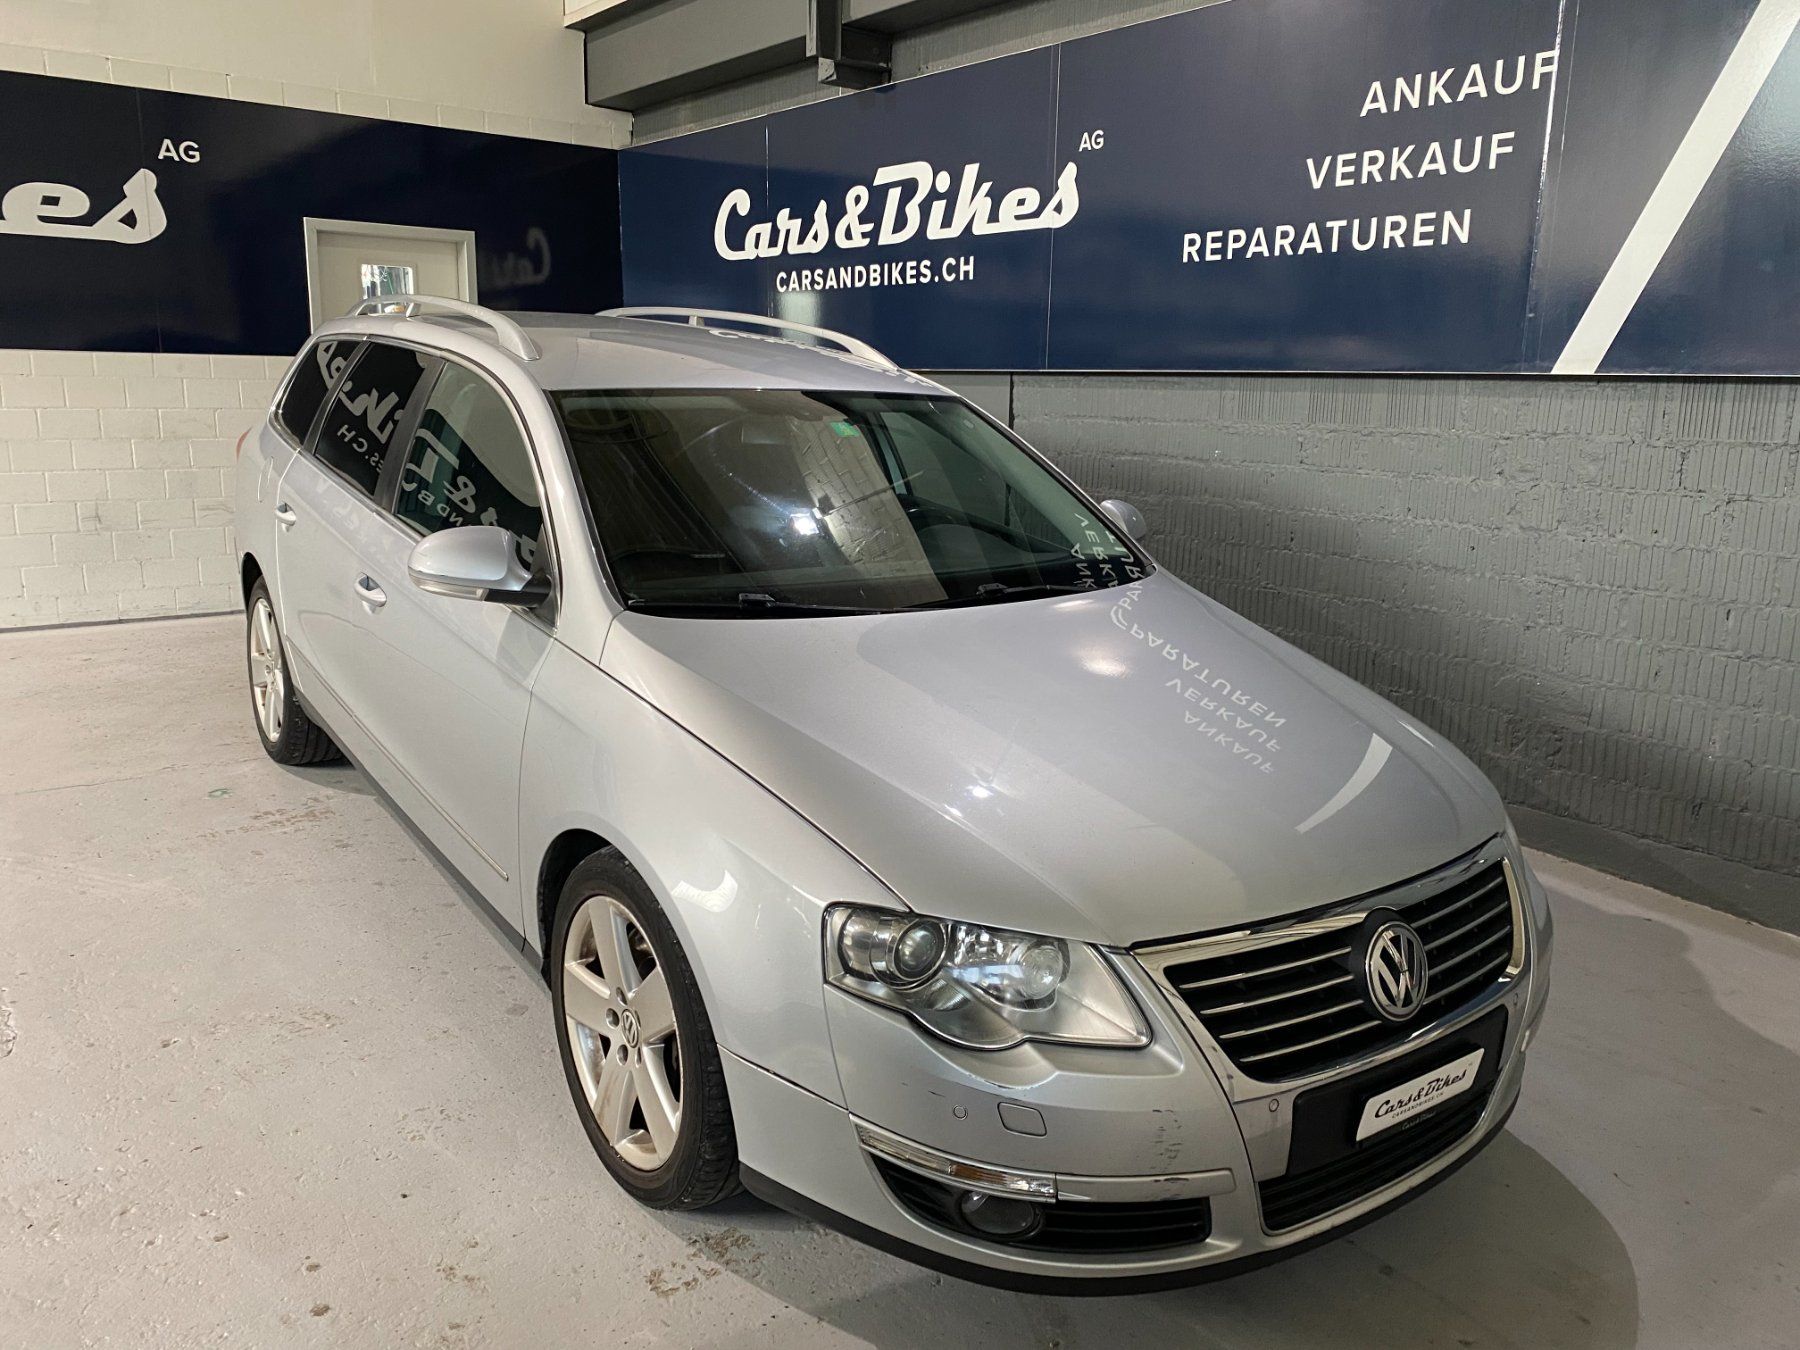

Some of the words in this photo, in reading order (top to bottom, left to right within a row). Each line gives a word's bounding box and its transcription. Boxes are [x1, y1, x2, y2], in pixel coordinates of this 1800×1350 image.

[1359, 50, 1558, 118] ANKAUF
[157, 138, 201, 163] AG
[1306, 131, 1516, 190] VERKAUF
[714, 160, 1080, 261] Cars&Bikes
[1078, 129, 1105, 152] AG
[1182, 208, 1472, 263] REPARATUREN
[776, 255, 975, 293] CARSANDBIKES.CH
